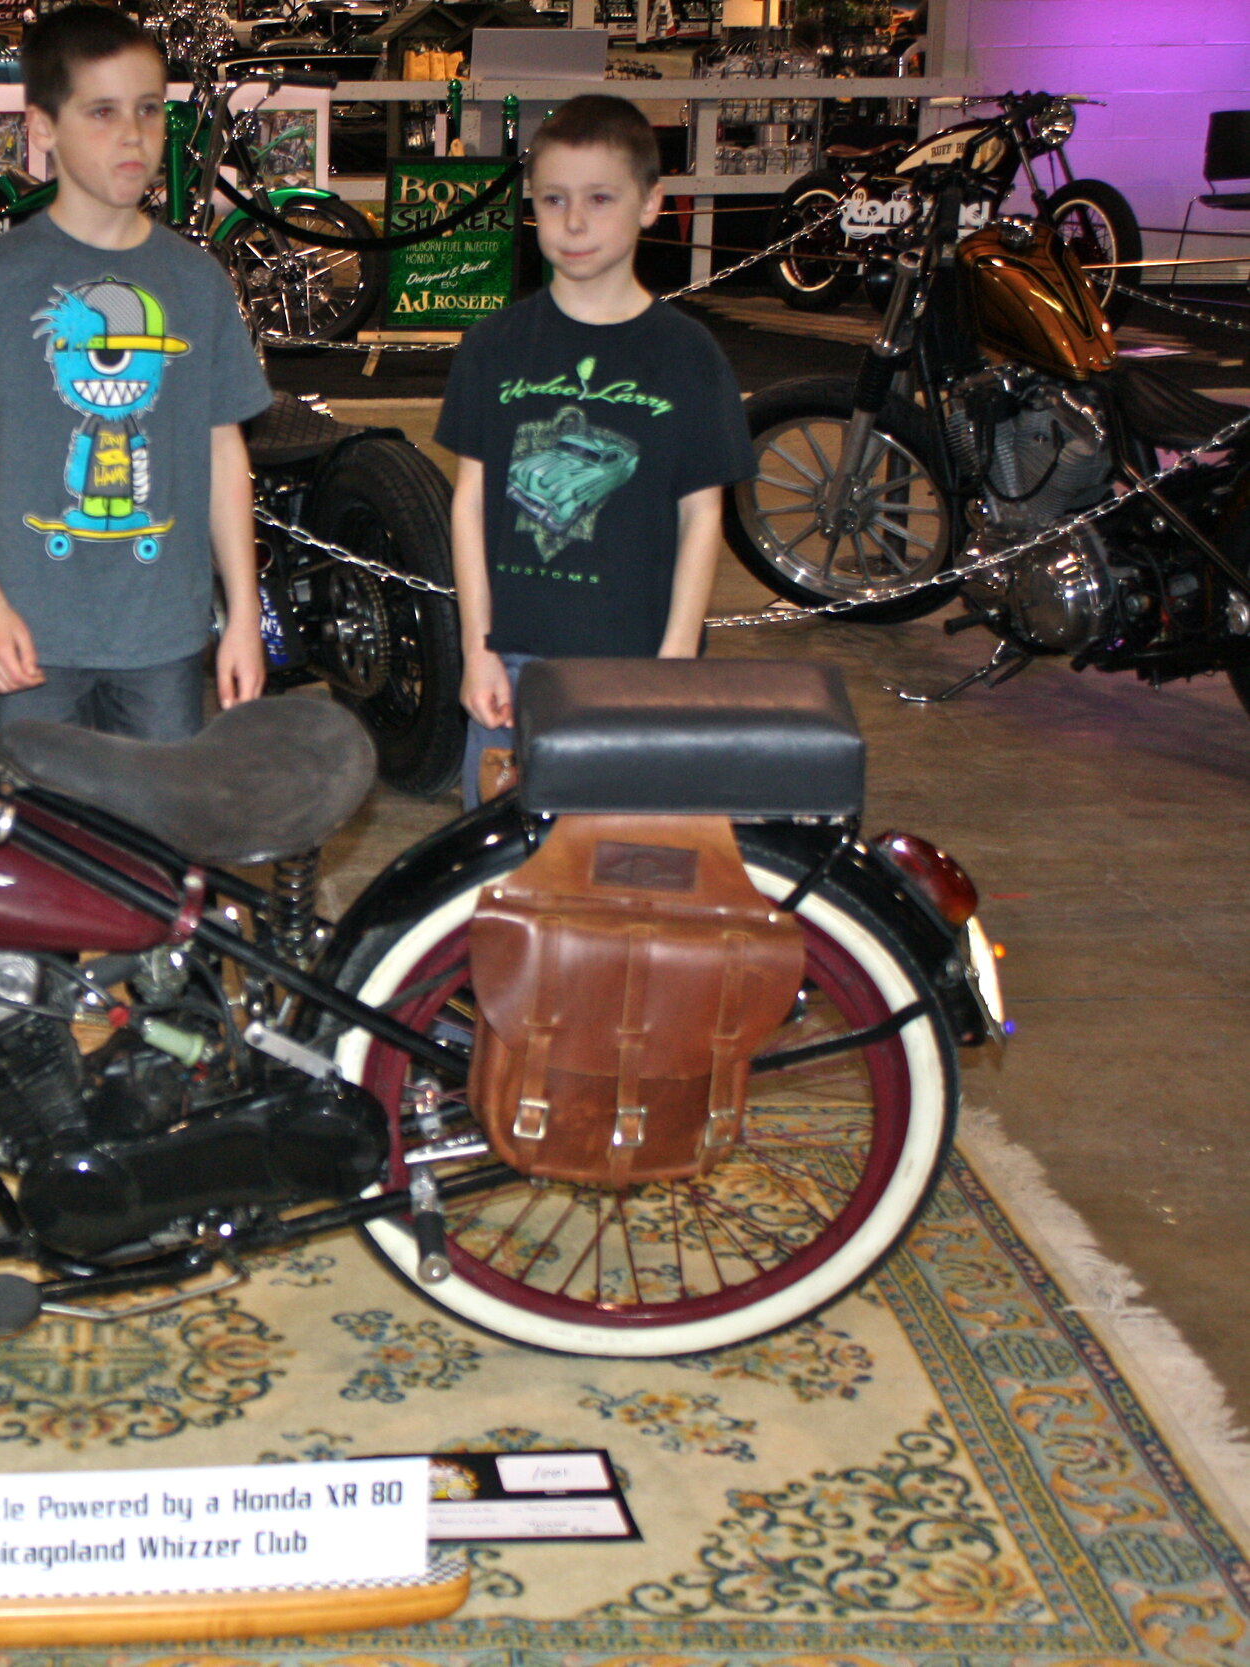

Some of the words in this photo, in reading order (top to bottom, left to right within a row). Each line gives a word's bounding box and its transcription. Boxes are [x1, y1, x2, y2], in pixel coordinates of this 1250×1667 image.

[391, 208, 514, 232] SHER
[406, 252, 435, 265] HONDA
[444, 241, 462, 252] FUEL
[464, 241, 500, 252] INJECTED
[406, 270, 449, 285] Designed
[460, 260, 491, 274] Built
[432, 295, 506, 310] ROSEEN
[585, 380, 673, 416] Larry
[39, 1493, 148, 1520] Powered
[163, 1492, 192, 1522] by
[206, 1495, 219, 1513] a
[234, 1487, 311, 1512] Honda
[326, 1483, 357, 1508] XR
[371, 1480, 403, 1506] 80
[138, 1535, 242, 1560] Whizzer
[255, 1530, 307, 1555] Club
